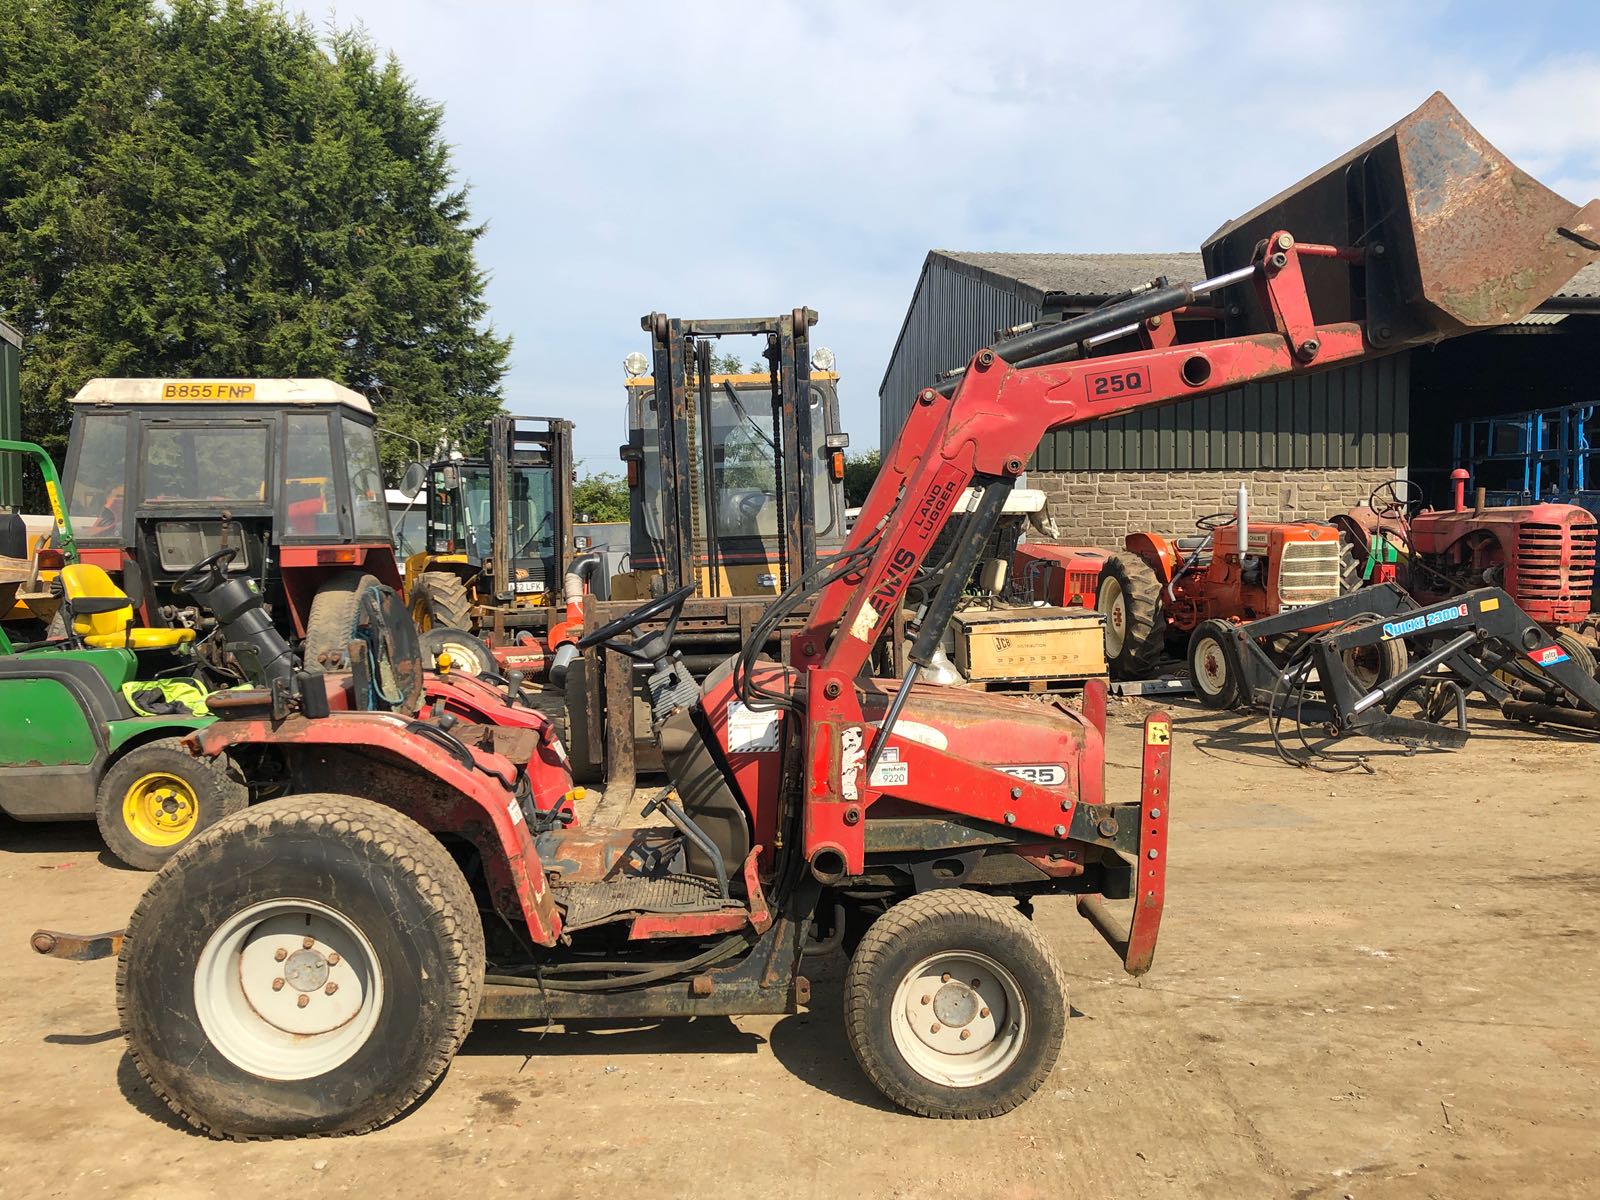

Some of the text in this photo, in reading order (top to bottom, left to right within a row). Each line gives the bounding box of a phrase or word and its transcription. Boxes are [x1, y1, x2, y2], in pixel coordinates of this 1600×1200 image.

[165, 385, 252, 398] B855 FNP
[914, 484, 942, 527] LAND
[919, 481, 956, 540] LUGGER
[995, 637, 1012, 651] JCB
[882, 773, 905, 783] 9220
[1005, 768, 1055, 783] 35
